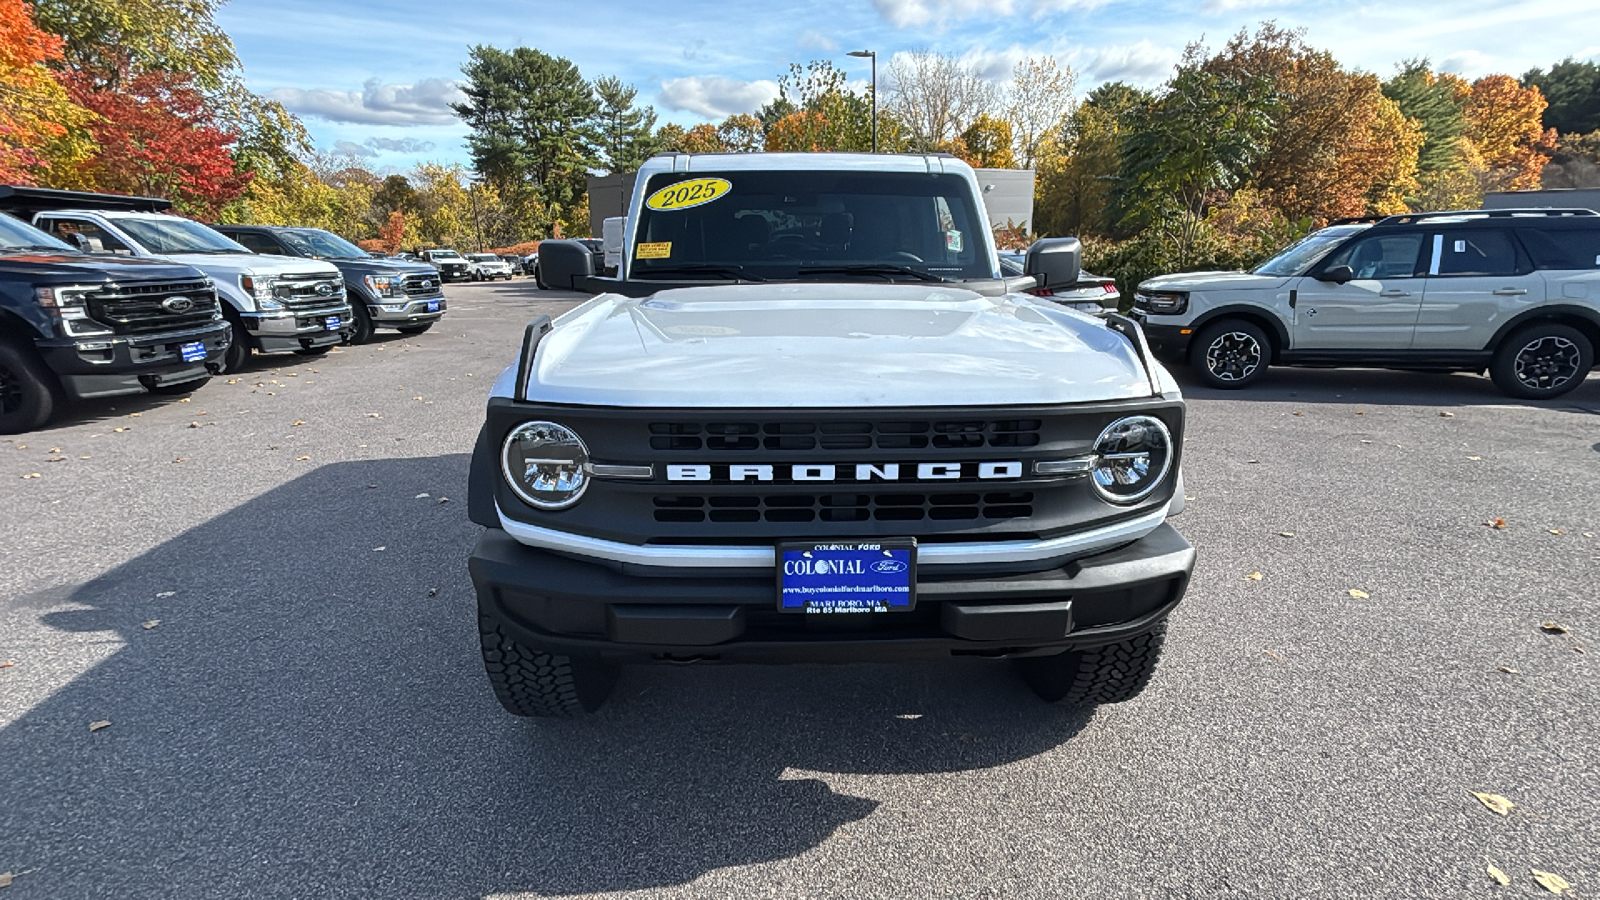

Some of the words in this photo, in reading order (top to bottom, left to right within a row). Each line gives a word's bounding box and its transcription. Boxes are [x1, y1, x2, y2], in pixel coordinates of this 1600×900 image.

[661, 181, 717, 207] 2025
[666, 461, 1023, 481] BRONCO
[858, 543, 881, 551] FORD
[784, 559, 866, 576] COLONIAL
[877, 560, 900, 570] Ford
[783, 585, 910, 595] www.buycolonialfordmarlboro.com
